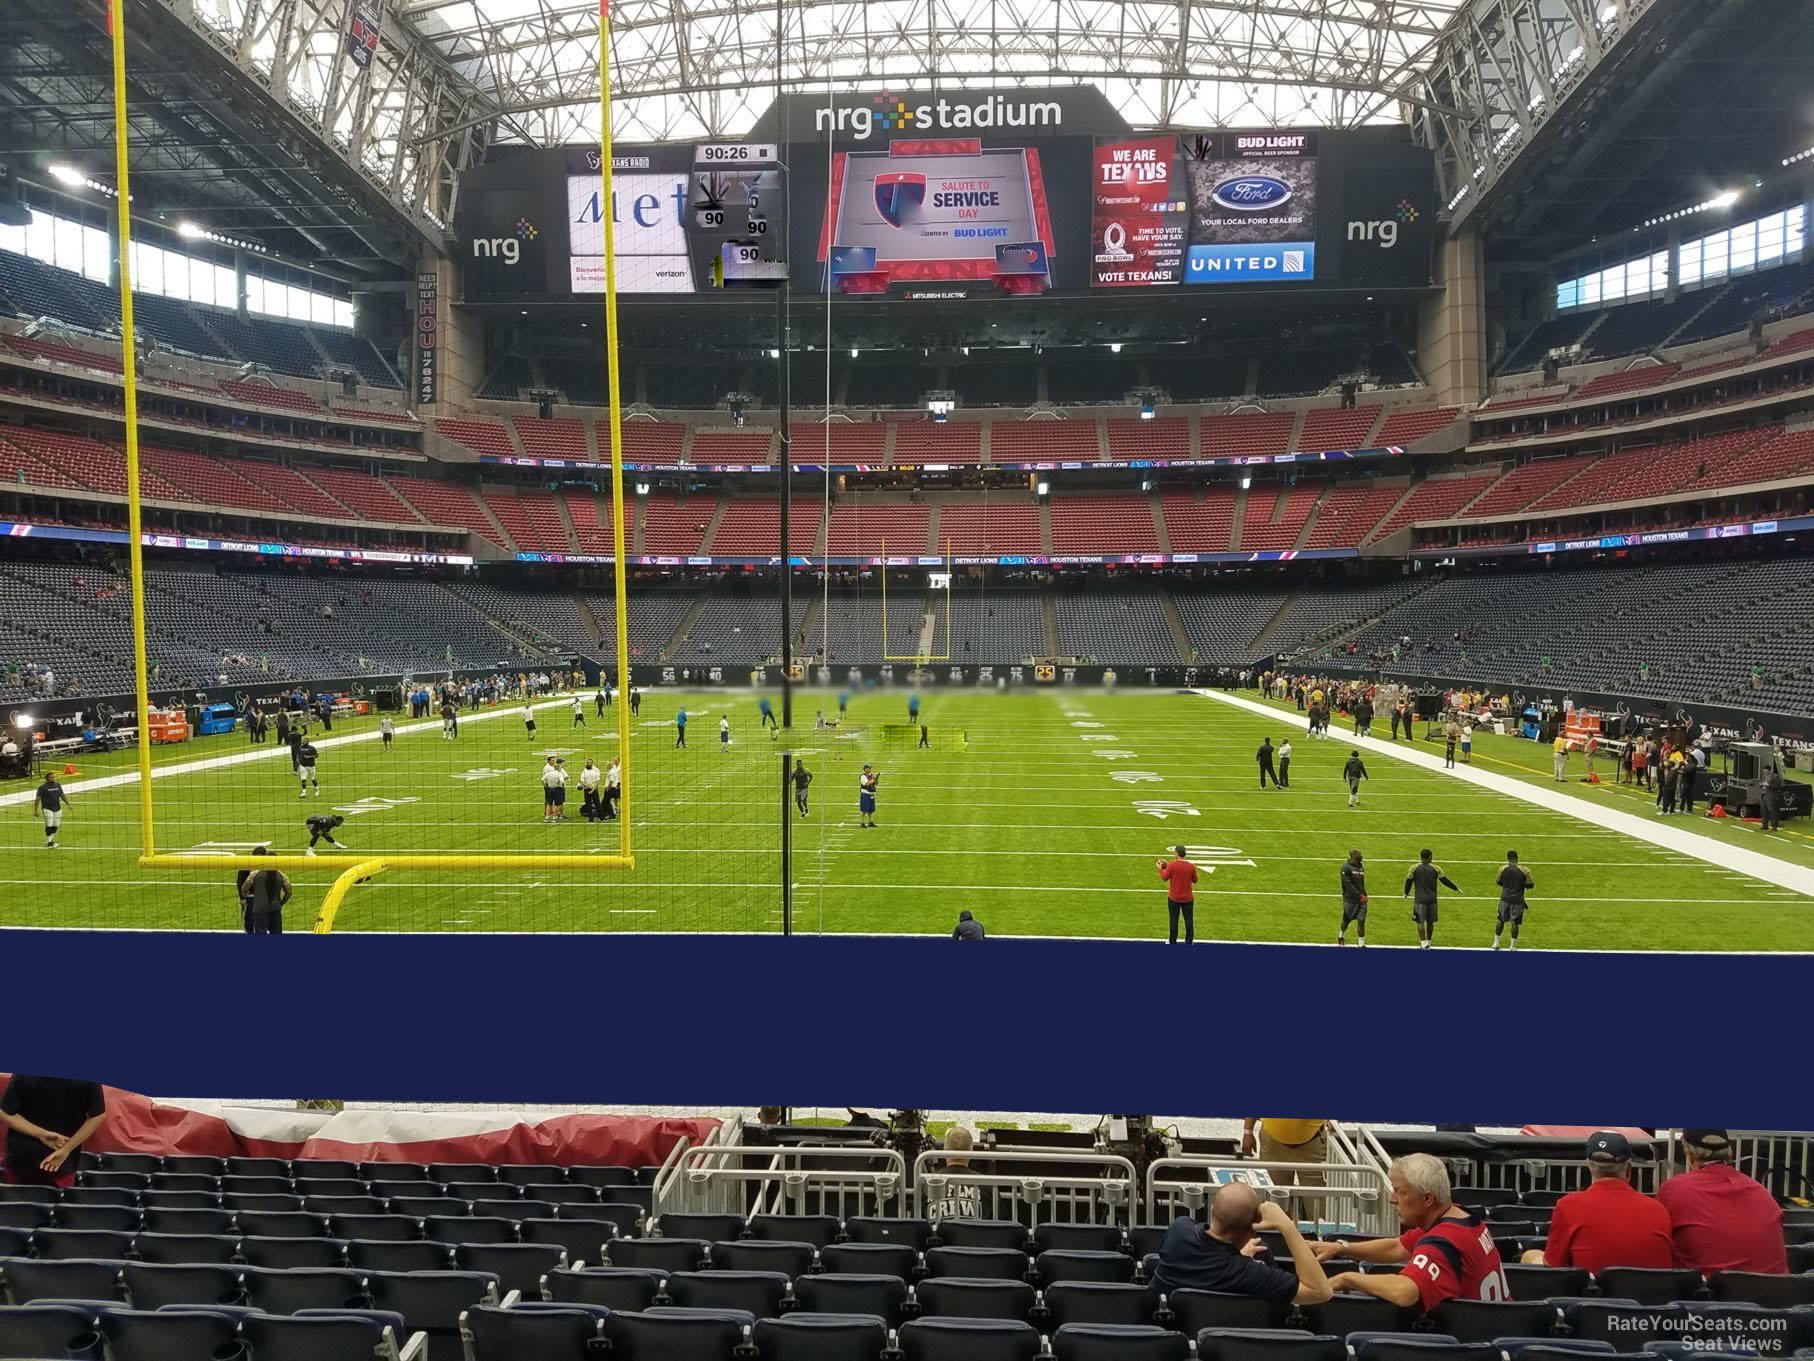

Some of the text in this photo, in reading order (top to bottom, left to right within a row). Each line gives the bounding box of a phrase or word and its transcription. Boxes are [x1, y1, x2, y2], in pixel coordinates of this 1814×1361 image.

[815, 95, 1062, 140] nrg stadium
[1237, 136, 1305, 149] BUD LIGHT
[705, 147, 748, 160] 90:26
[1112, 149, 1156, 161] WE ARE
[941, 181, 990, 191] SALUTE TO
[1230, 183, 1273, 200] Ford
[933, 191, 1000, 208] SERVICE
[705, 212, 724, 225] 90
[958, 209, 979, 219] DAY
[748, 222, 767, 234] 90
[954, 229, 976, 238] BUD
[977, 228, 1008, 238] LIGHT
[1347, 219, 1397, 248] nrg
[473, 237, 520, 265] nrg
[740, 249, 759, 261] 90
[1191, 256, 1277, 271] UNITED
[418, 274, 436, 282] NEED
[656, 270, 685, 278] verizon
[1098, 270, 1172, 282] VOTE TEXANS!
[418, 282, 437, 290] HELP?
[420, 290, 435, 298] TEXT
[1642, 531, 1689, 543] HOUSTON TEXANS
[221, 541, 260, 552] DETROIT LIONS
[1565, 540, 1600, 550] DETROIT LIONS
[662, 671, 676, 681] 56
[1039, 667, 1052, 677] 25
[1413, 1254, 1440, 1281] 99
